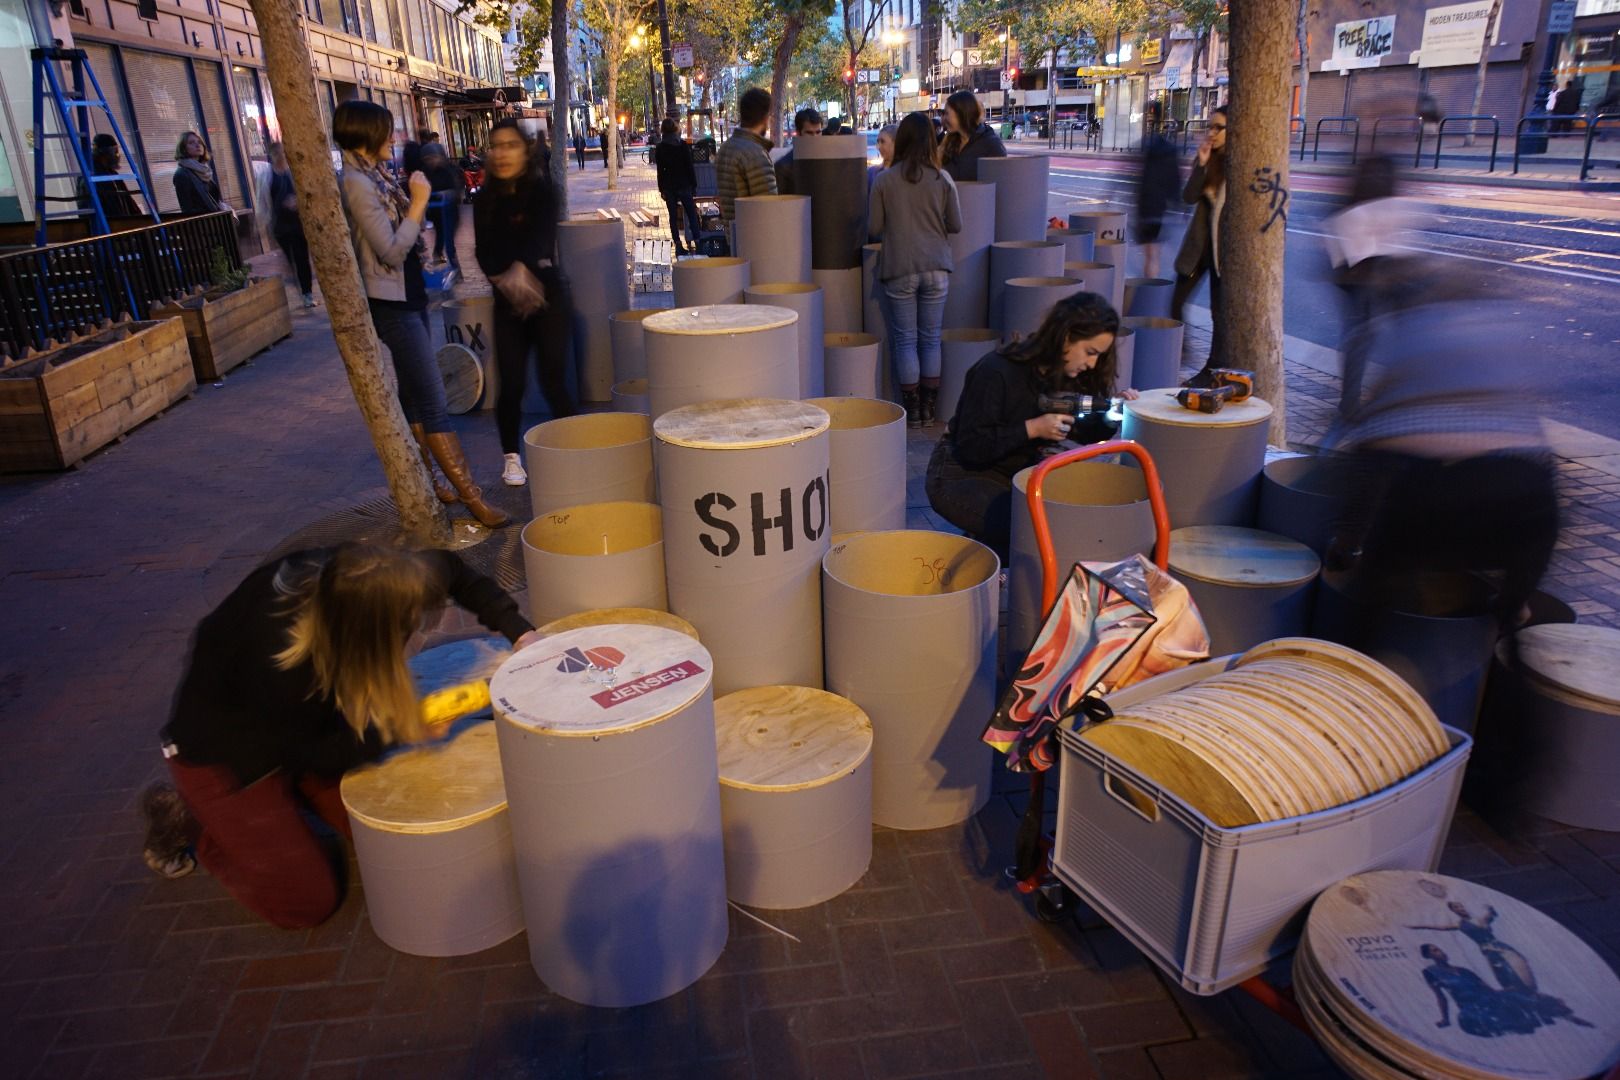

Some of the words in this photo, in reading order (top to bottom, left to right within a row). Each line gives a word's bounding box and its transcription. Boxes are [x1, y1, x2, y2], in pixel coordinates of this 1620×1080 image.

[1429, 14, 1451, 25] HIDDEN
[1452, 9, 1489, 22] TREASURES
[1338, 26, 1366, 48] FREE
[1356, 33, 1392, 57] SPACE
[548, 514, 570, 525] TOP
[694, 468, 831, 557] SHO
[913, 556, 952, 586] 38
[610, 667, 690, 702] JENSEN
